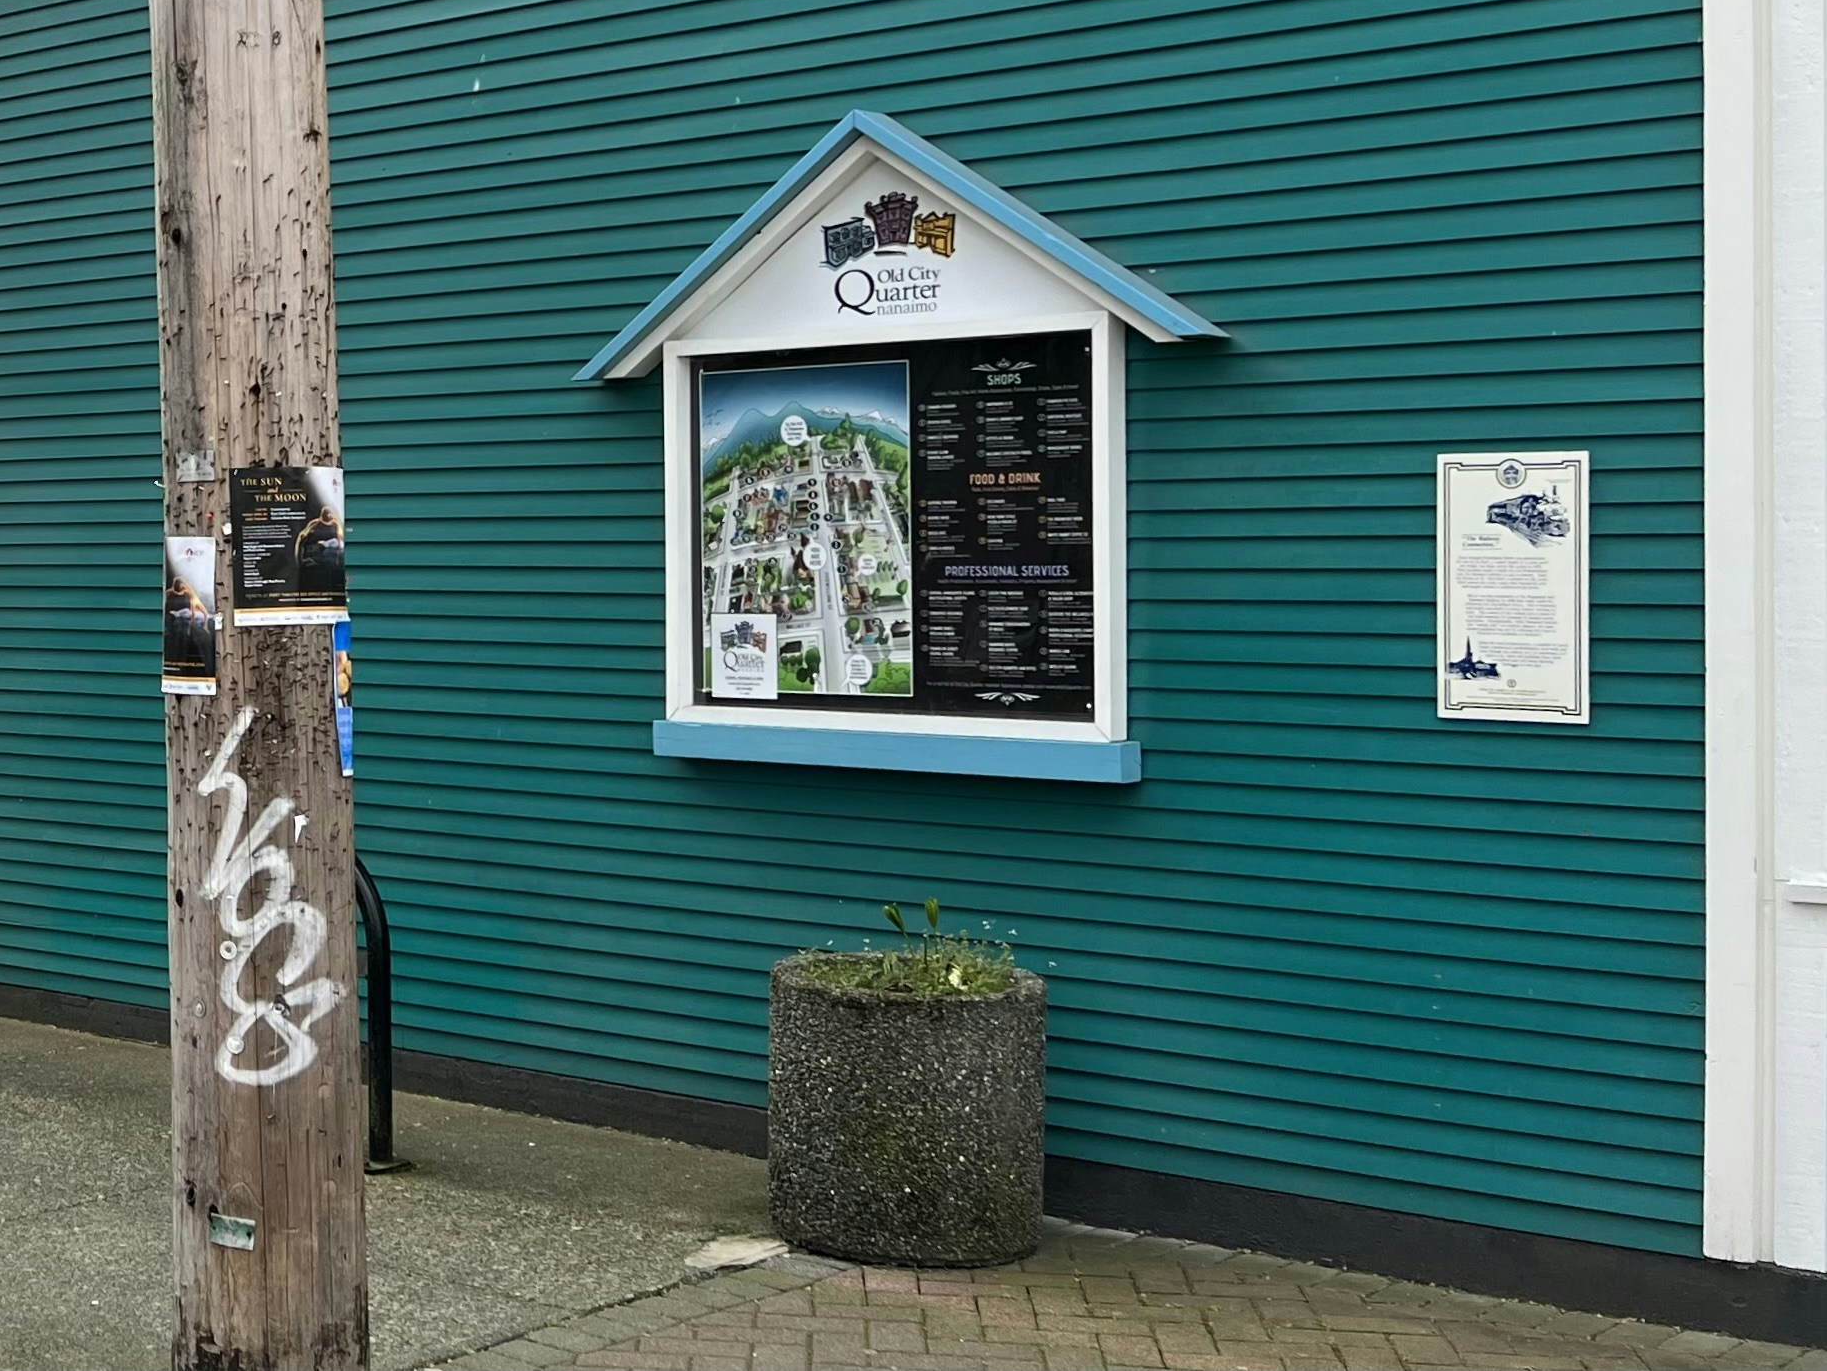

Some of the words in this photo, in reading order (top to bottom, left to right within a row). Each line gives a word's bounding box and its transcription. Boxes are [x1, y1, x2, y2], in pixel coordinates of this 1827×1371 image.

[877, 268, 904, 284] Old
[908, 266, 941, 282] City
[834, 269, 941, 315] Quarter
[876, 302, 937, 316] nanaimo
[986, 373, 1022, 386] SHOPS
[260, 477, 282, 486] SUN
[969, 474, 995, 485] FOOD
[998, 473, 1005, 484] &
[1008, 473, 1041, 484] DRINK
[254, 494, 273, 502] THE
[274, 493, 308, 503] MOON
[944, 565, 1019, 577] PROFESSIONAL
[1021, 564, 1070, 576] SERVICES
